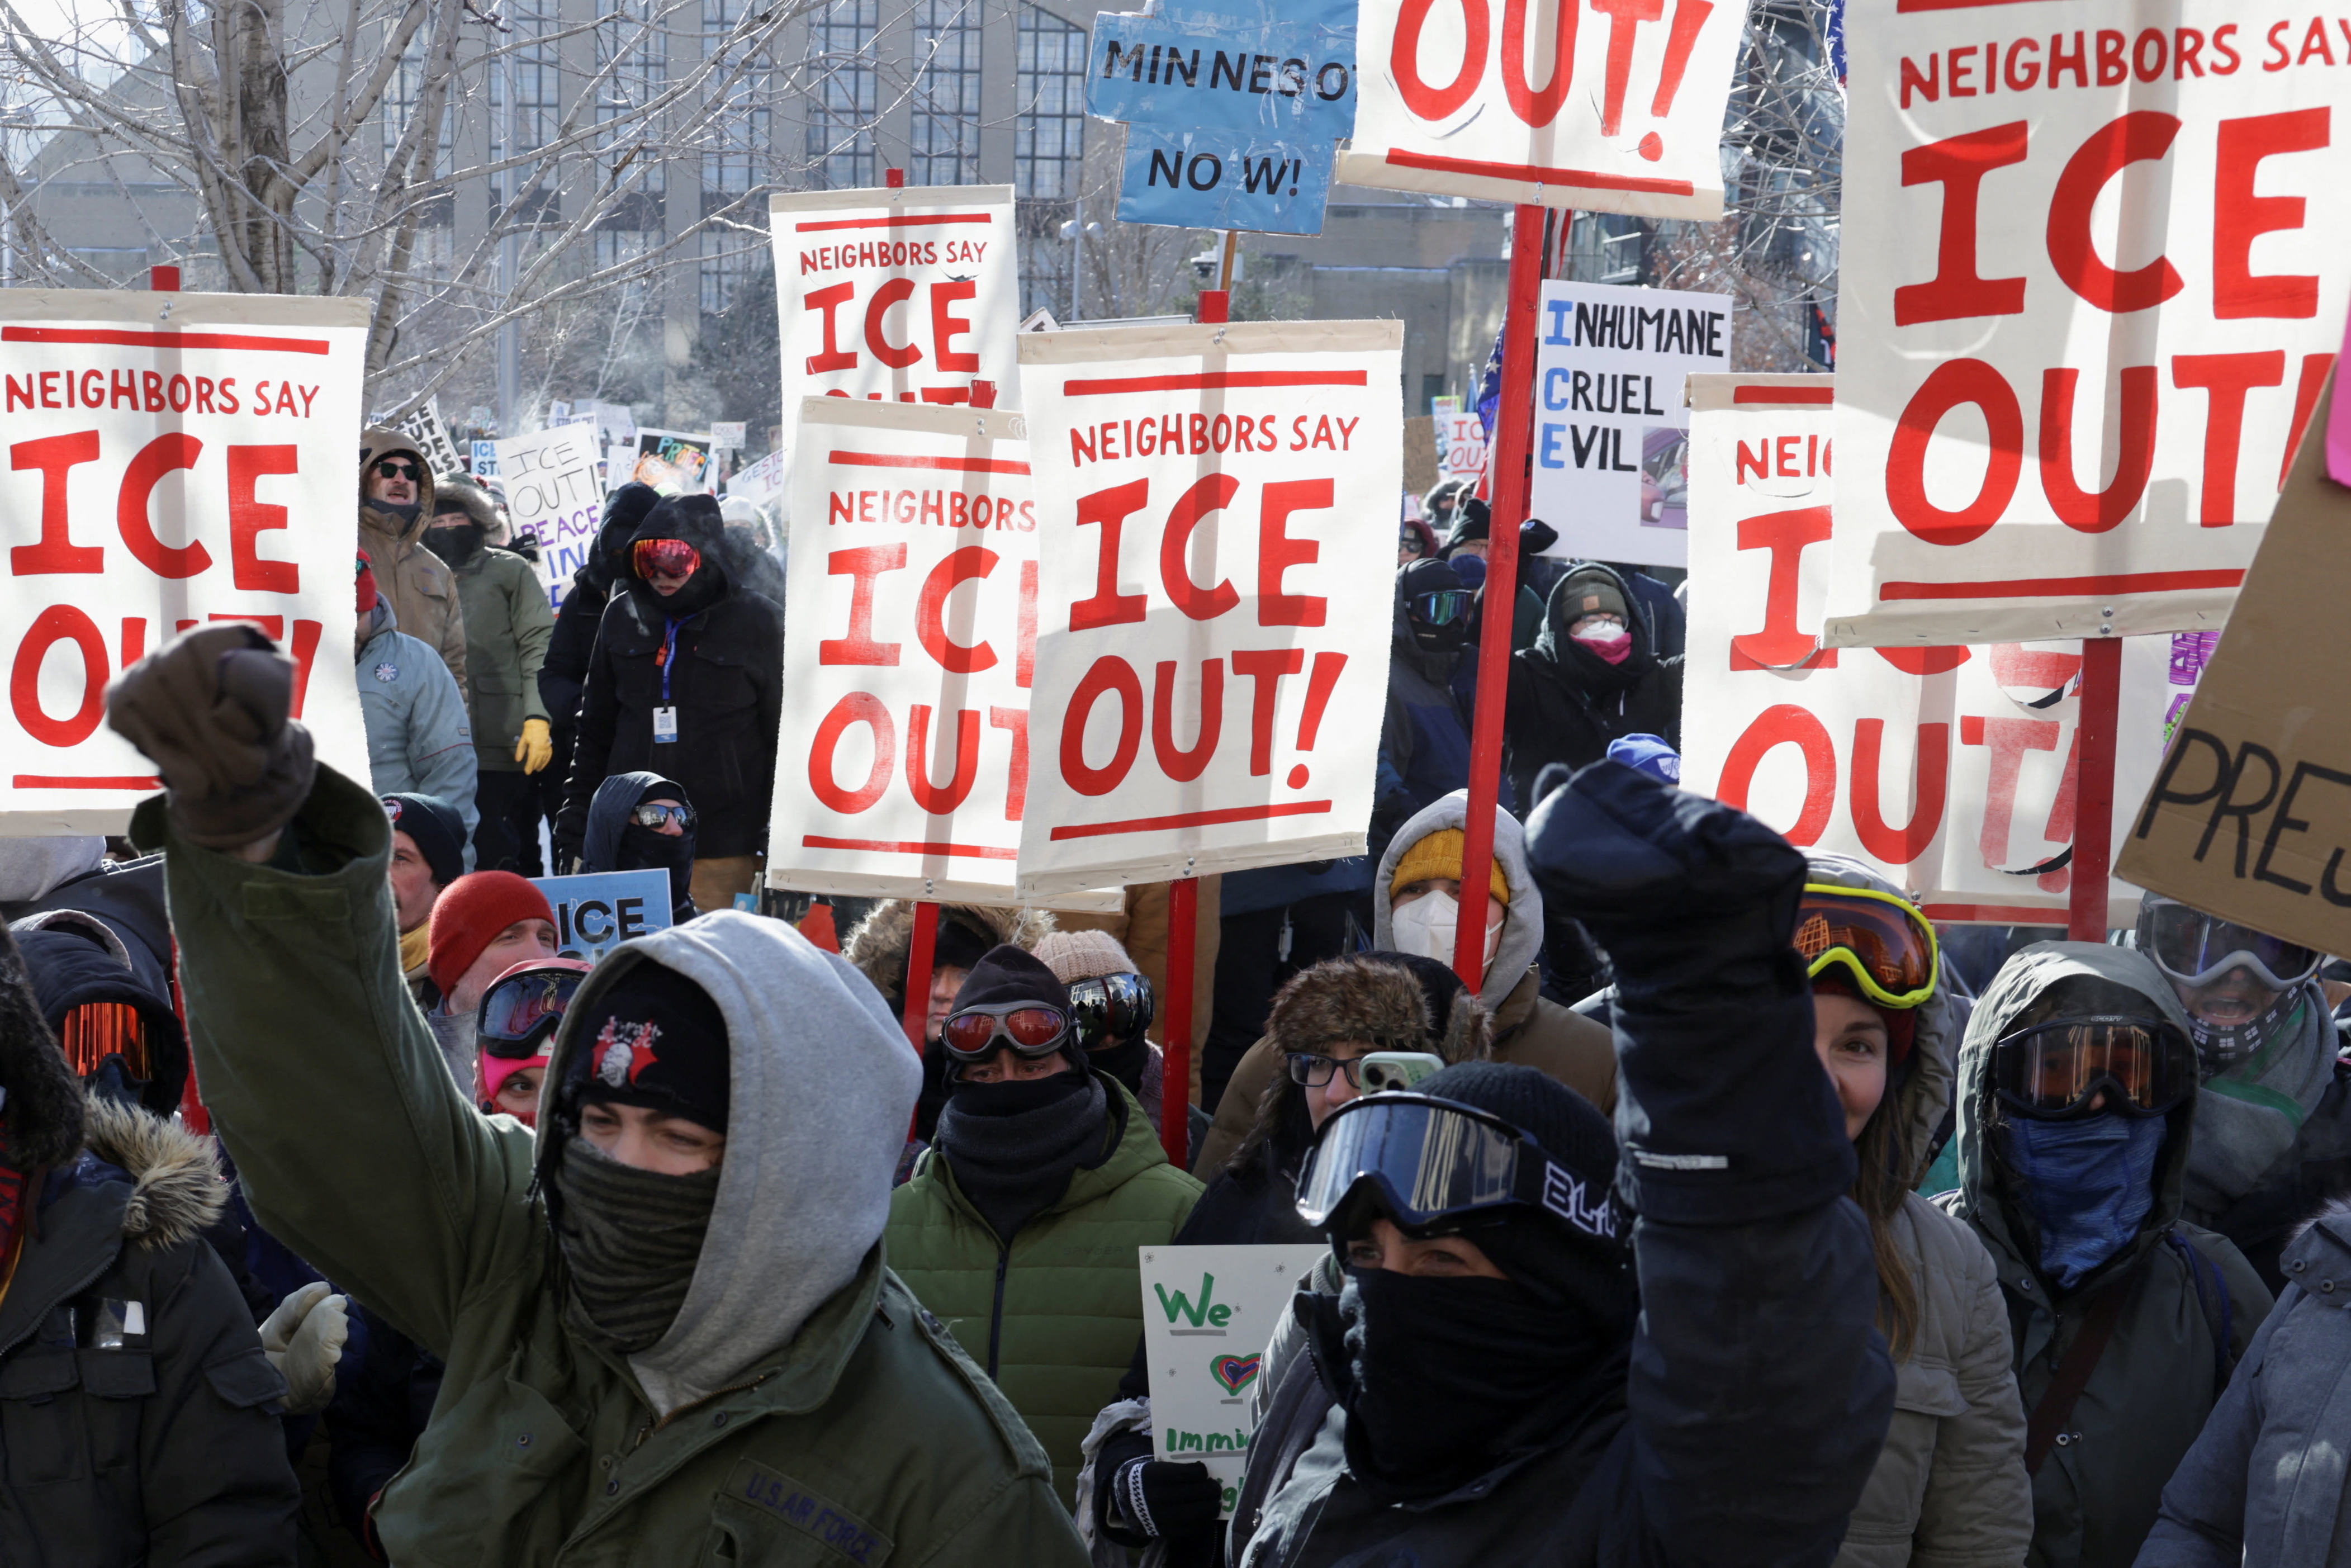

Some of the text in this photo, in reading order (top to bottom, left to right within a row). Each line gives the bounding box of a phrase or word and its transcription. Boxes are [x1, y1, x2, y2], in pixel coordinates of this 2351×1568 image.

[1103, 40, 1357, 102] MINNESO
[1391, 0, 1714, 162] OUT!
[1901, 23, 2241, 108] NEIGHBORS
[1148, 149, 1301, 197] NOW!
[1895, 106, 2331, 326] ICE
[801, 240, 988, 276] NEIGHBORS SAY
[804, 277, 979, 375] ICE
[1544, 300, 1725, 358] INHUMANE
[6, 369, 320, 418] NEIGHBORS SAY
[1544, 367, 1664, 415] CRUEL
[1071, 413, 1359, 467] NEIGHBORS SAY
[1452, 420, 1485, 441] IC
[1540, 421, 1637, 472] EVIL
[508, 442, 580, 480] ICE
[1451, 447, 1485, 467] OU
[10, 429, 300, 594] ICE
[514, 465, 599, 517] OUT!
[829, 490, 1036, 530] NEIGHBORS
[520, 505, 599, 547] PEACE
[1069, 472, 1334, 632] ICE
[547, 542, 585, 579] IN
[1060, 648, 1349, 796] OUT!
[558, 898, 647, 945] ICE
[1154, 1272, 1232, 1328] We
[780, 1491, 817, 1526] AIR
[810, 1507, 880, 1565] FORCE
